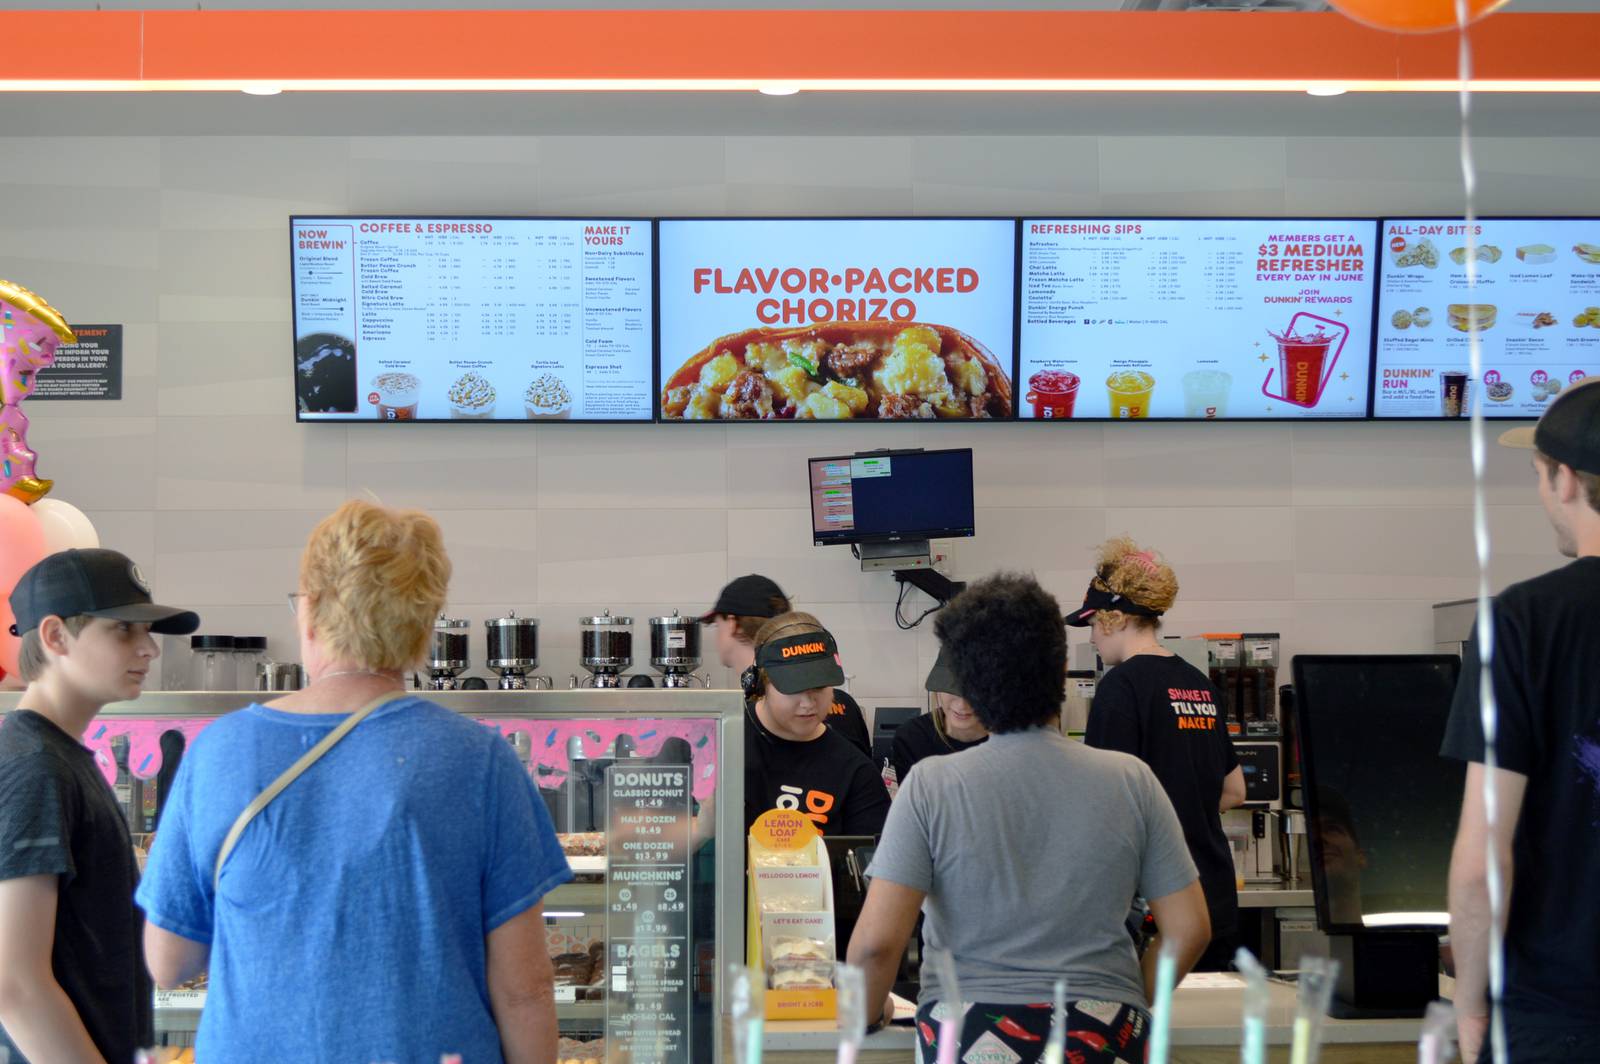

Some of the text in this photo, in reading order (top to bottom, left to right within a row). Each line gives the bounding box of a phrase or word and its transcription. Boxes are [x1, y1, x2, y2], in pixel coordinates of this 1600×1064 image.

[360, 223, 493, 233] COFFEE & ESPRESSO
[585, 226, 630, 235] MAKE IT
[1031, 225, 1142, 234] REFRESHING SIPS
[1389, 225, 1482, 235] ALL-DAY BITS
[298, 230, 327, 239] NOW
[585, 237, 623, 246] YOURS
[1258, 244, 1363, 256] $3 MEDIUM
[1257, 259, 1363, 271] REFRESHER
[756, 298, 916, 324] CHORIZO
[1384, 369, 1434, 378] DUNKIN'
[1383, 380, 1408, 388] RUN
[782, 643, 825, 658] DUNKIN'
[1168, 688, 1212, 702] SHAKE IT
[1171, 702, 1216, 716] TILL YOU
[1208, 718, 1216, 730] IT
[614, 773, 683, 786] DONUTS
[765, 820, 803, 828] LEMON
[617, 944, 680, 957] BAGELS
